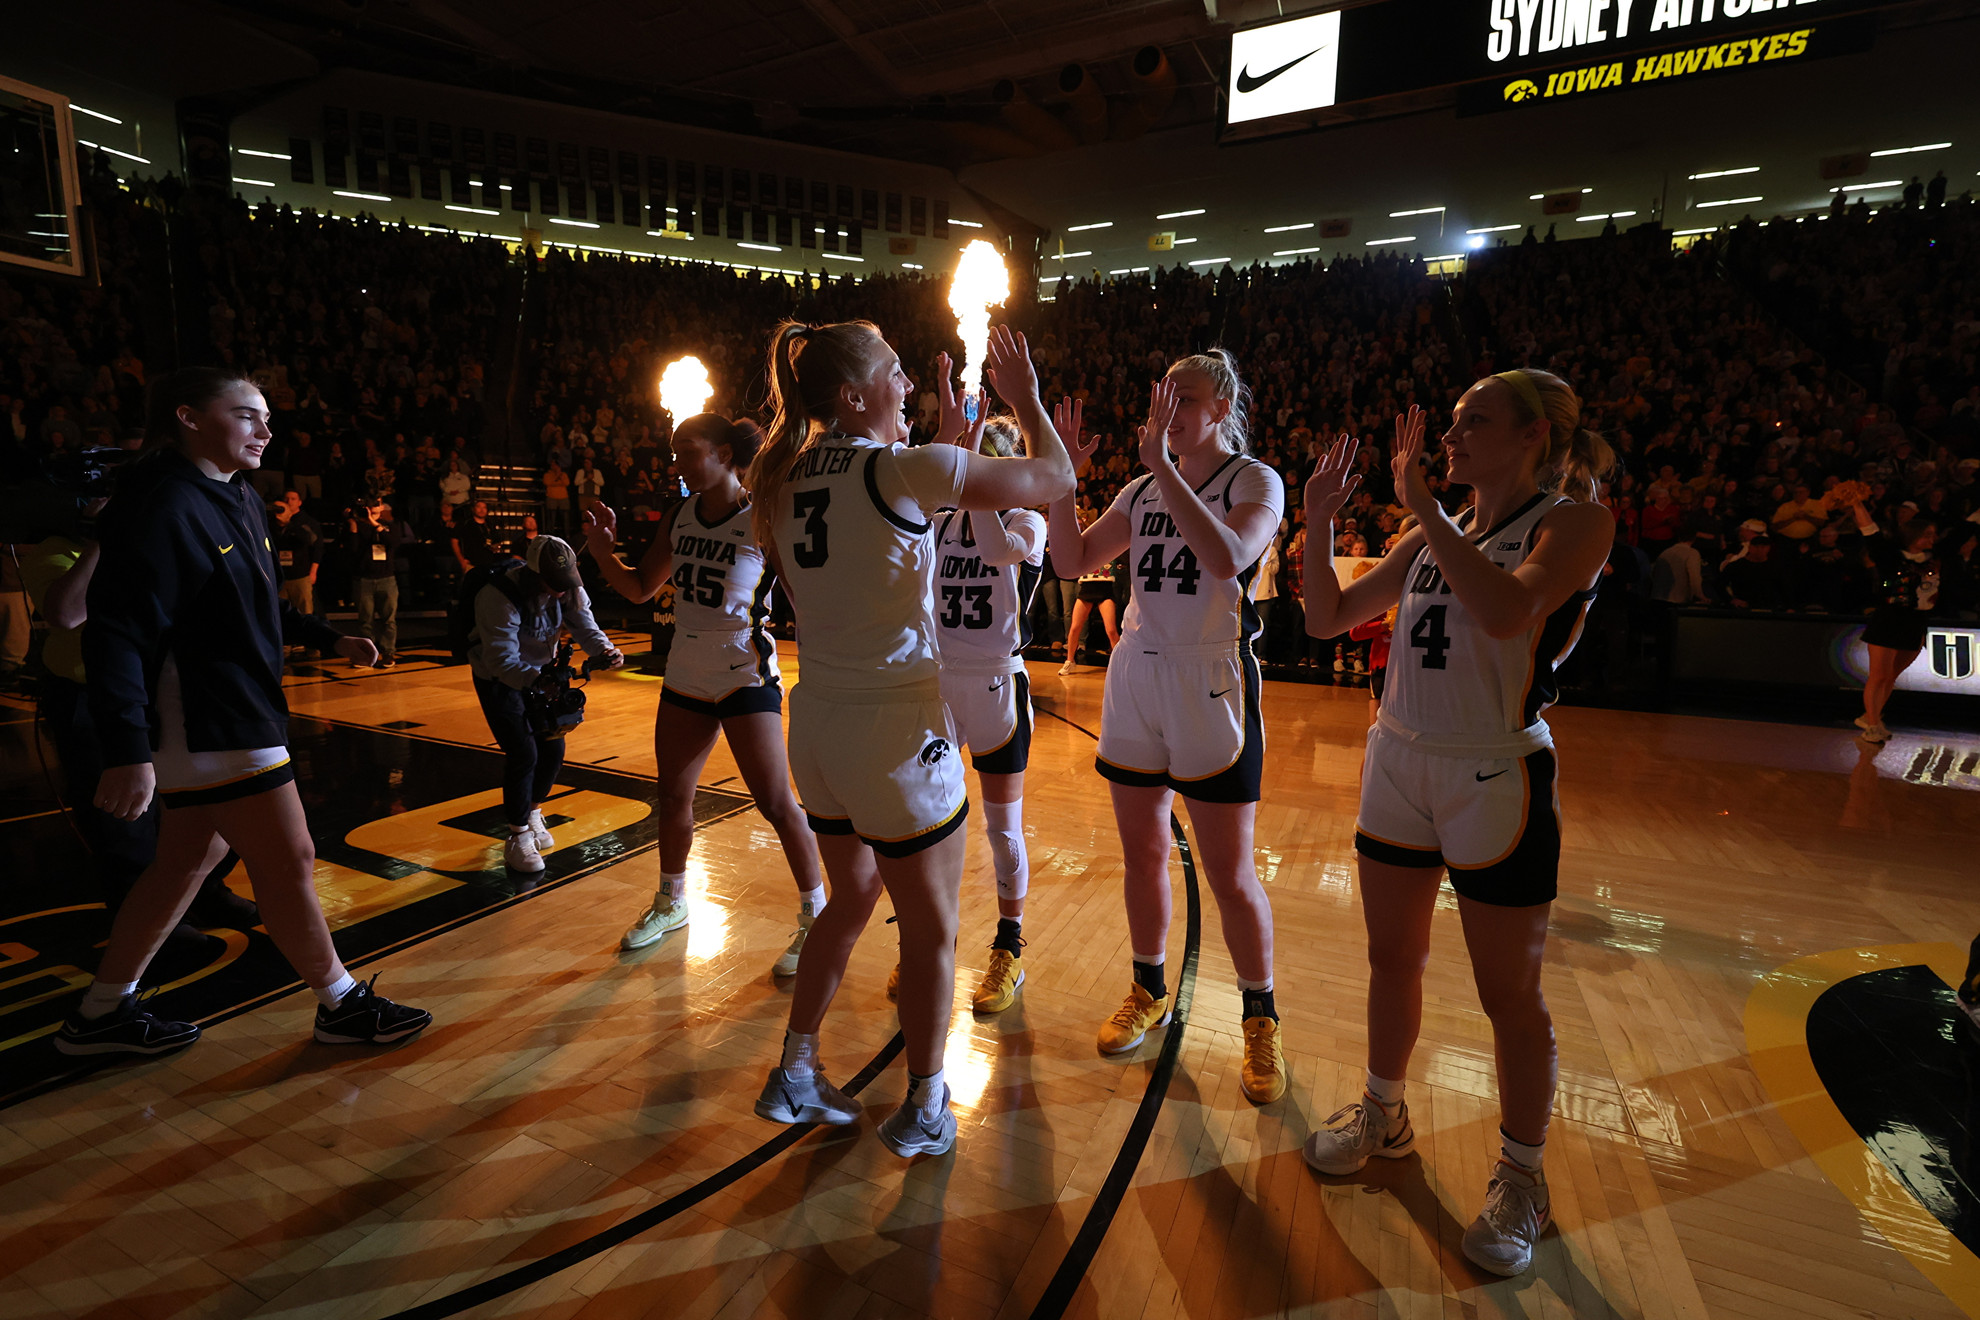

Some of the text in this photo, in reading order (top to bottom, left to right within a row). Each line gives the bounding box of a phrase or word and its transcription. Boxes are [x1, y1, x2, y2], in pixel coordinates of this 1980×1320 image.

[1543, 29, 1811, 98] IOWA HAWKEYES
[793, 487, 831, 569] 3
[1139, 512, 1182, 538] IO
[674, 535, 736, 566] IOWA
[941, 555, 999, 580] IOWA
[1137, 544, 1201, 595] 44
[674, 563, 726, 609] 45
[941, 585, 993, 630] 33
[1411, 605, 1451, 670] 4
